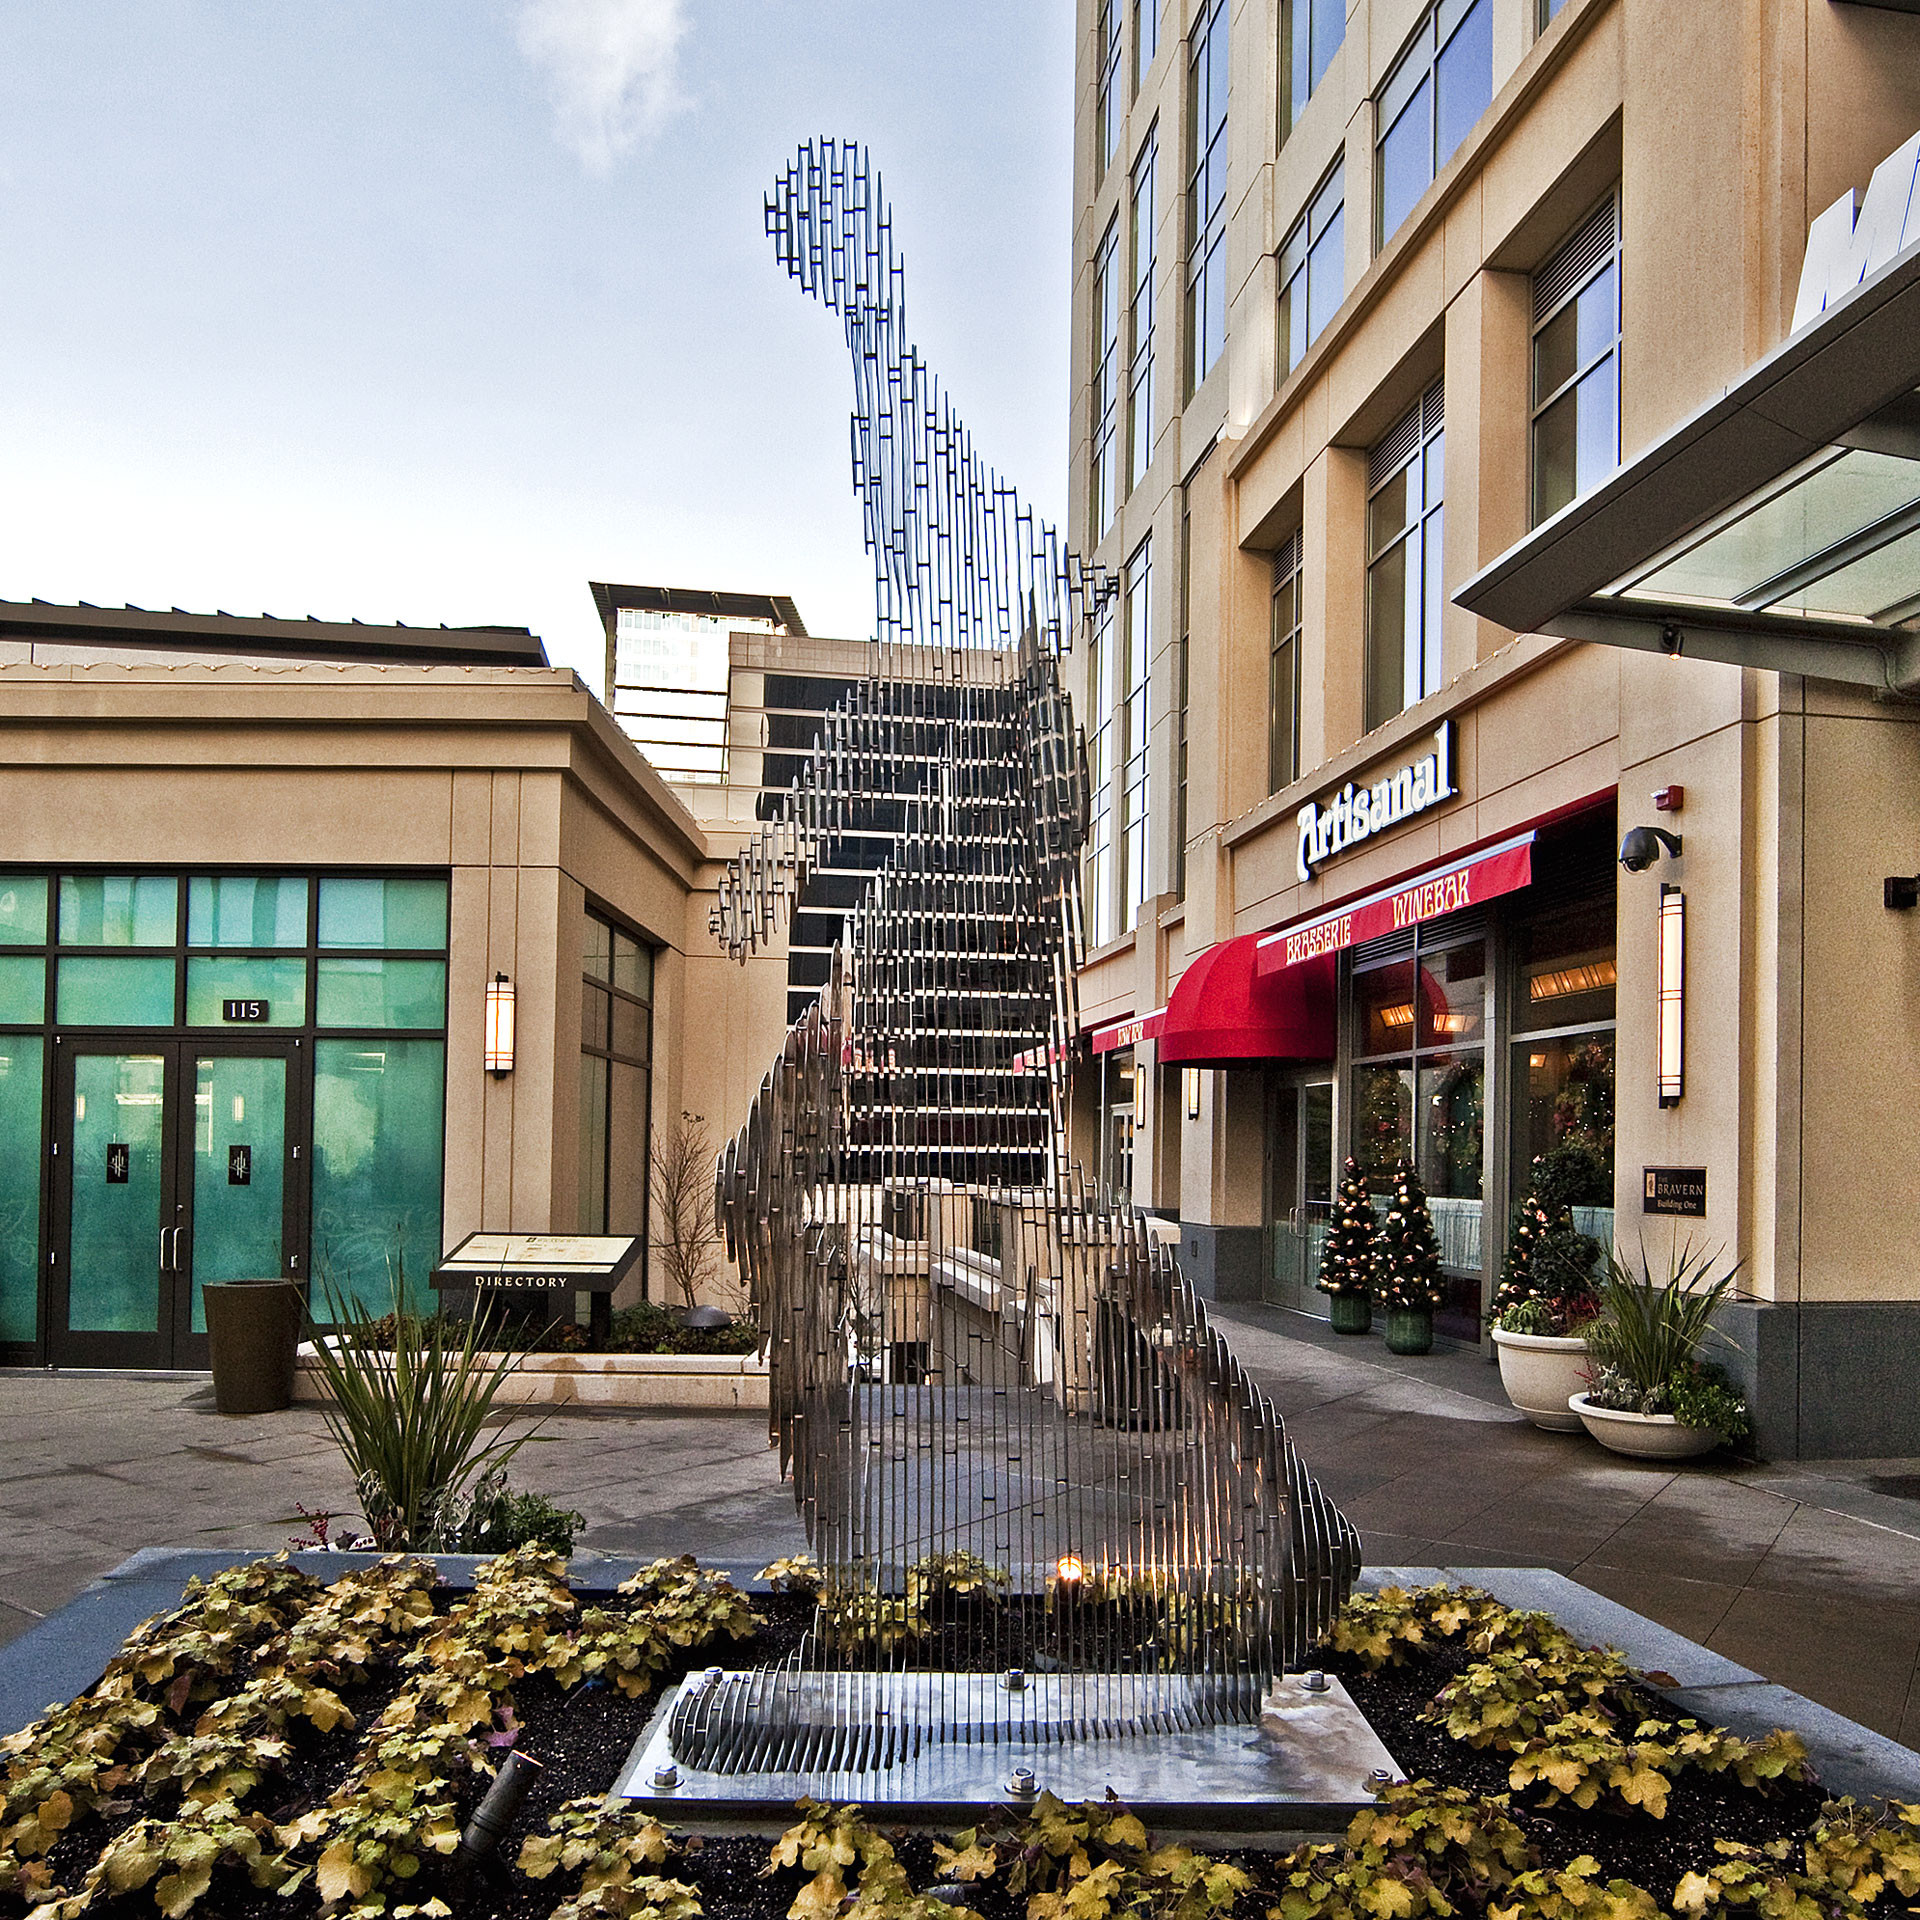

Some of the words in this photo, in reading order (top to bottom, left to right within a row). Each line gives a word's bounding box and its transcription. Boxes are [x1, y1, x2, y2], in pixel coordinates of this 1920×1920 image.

[1297, 719, 1451, 882] Artisanal
[1286, 915, 1352, 966] BRASSERIE
[231, 1002, 260, 1018] 115
[1657, 1183, 1704, 1196] BRAVERN
[1657, 1199, 1683, 1211] Building
[1683, 1200, 1697, 1210] One
[475, 1276, 567, 1288] DIRECTORY
